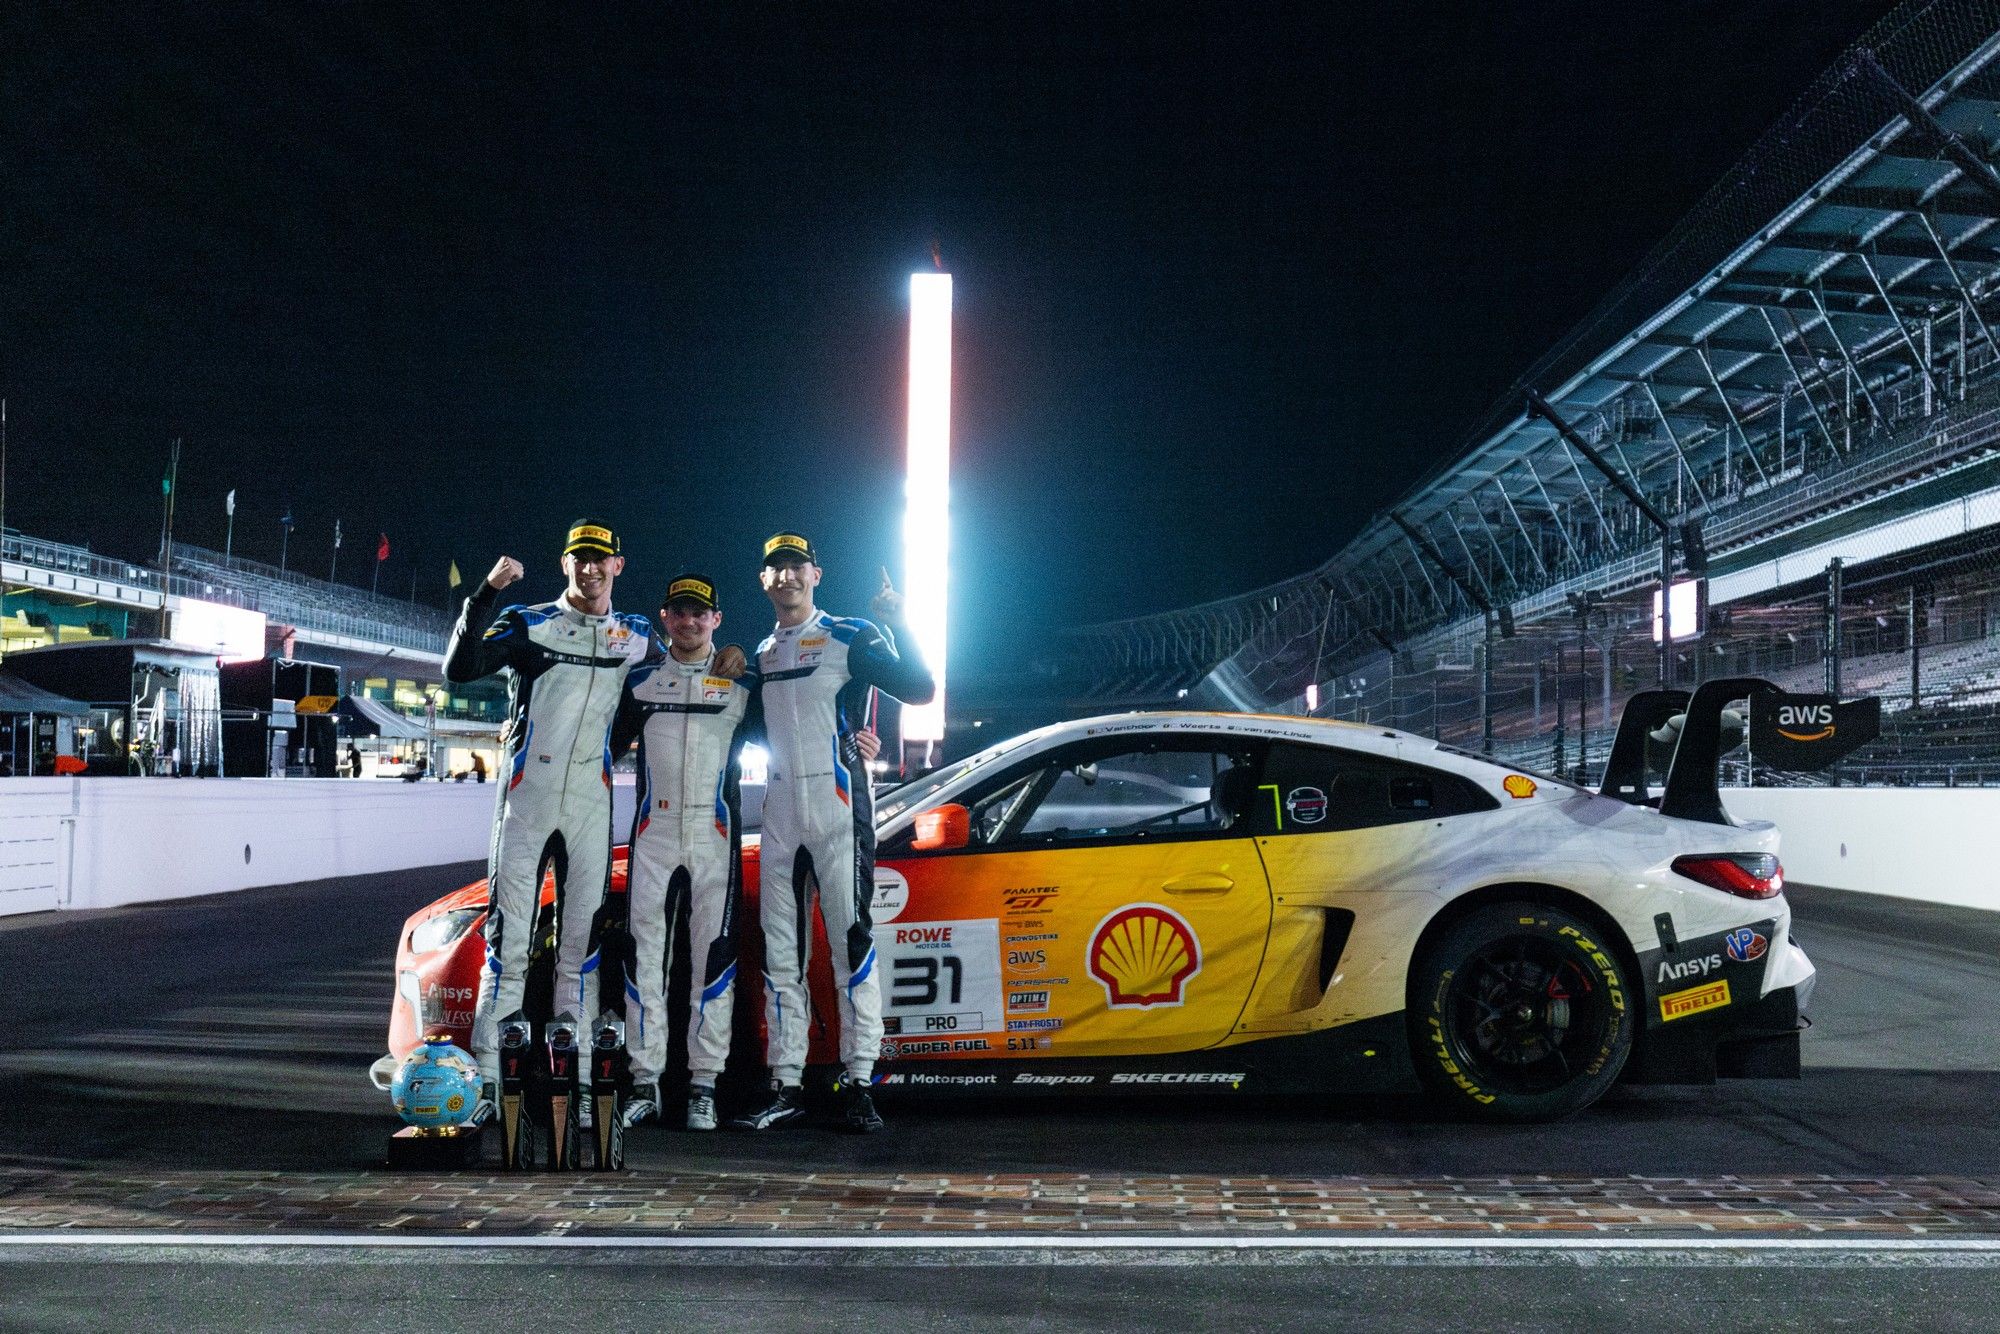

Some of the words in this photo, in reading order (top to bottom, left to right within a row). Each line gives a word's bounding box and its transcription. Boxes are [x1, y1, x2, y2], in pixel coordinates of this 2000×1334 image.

[1779, 705, 1833, 725] aws
[1003, 886, 1060, 895] FANATEC
[896, 927, 952, 944] ROWE
[1006, 934, 1058, 943] CROWDSTRIKE
[1725, 928, 1755, 961] VP
[1008, 949, 1047, 965] aws
[1658, 954, 1722, 983] Ansys
[891, 956, 962, 1006] 31
[1008, 977, 1070, 987] PERSHING
[428, 983, 473, 1003] Ansys
[1011, 993, 1046, 1003] OPTIMA
[1664, 985, 1726, 1016] PIRELLI
[926, 1016, 957, 1030] PRO
[901, 1041, 949, 1054] SUPER
[955, 1040, 991, 1051] FUEL
[1008, 1038, 1036, 1050] 5.11
[911, 1074, 997, 1085] Motorsport
[1013, 1073, 1095, 1085] Snap-on
[1110, 1073, 1246, 1083] SKECHERS
